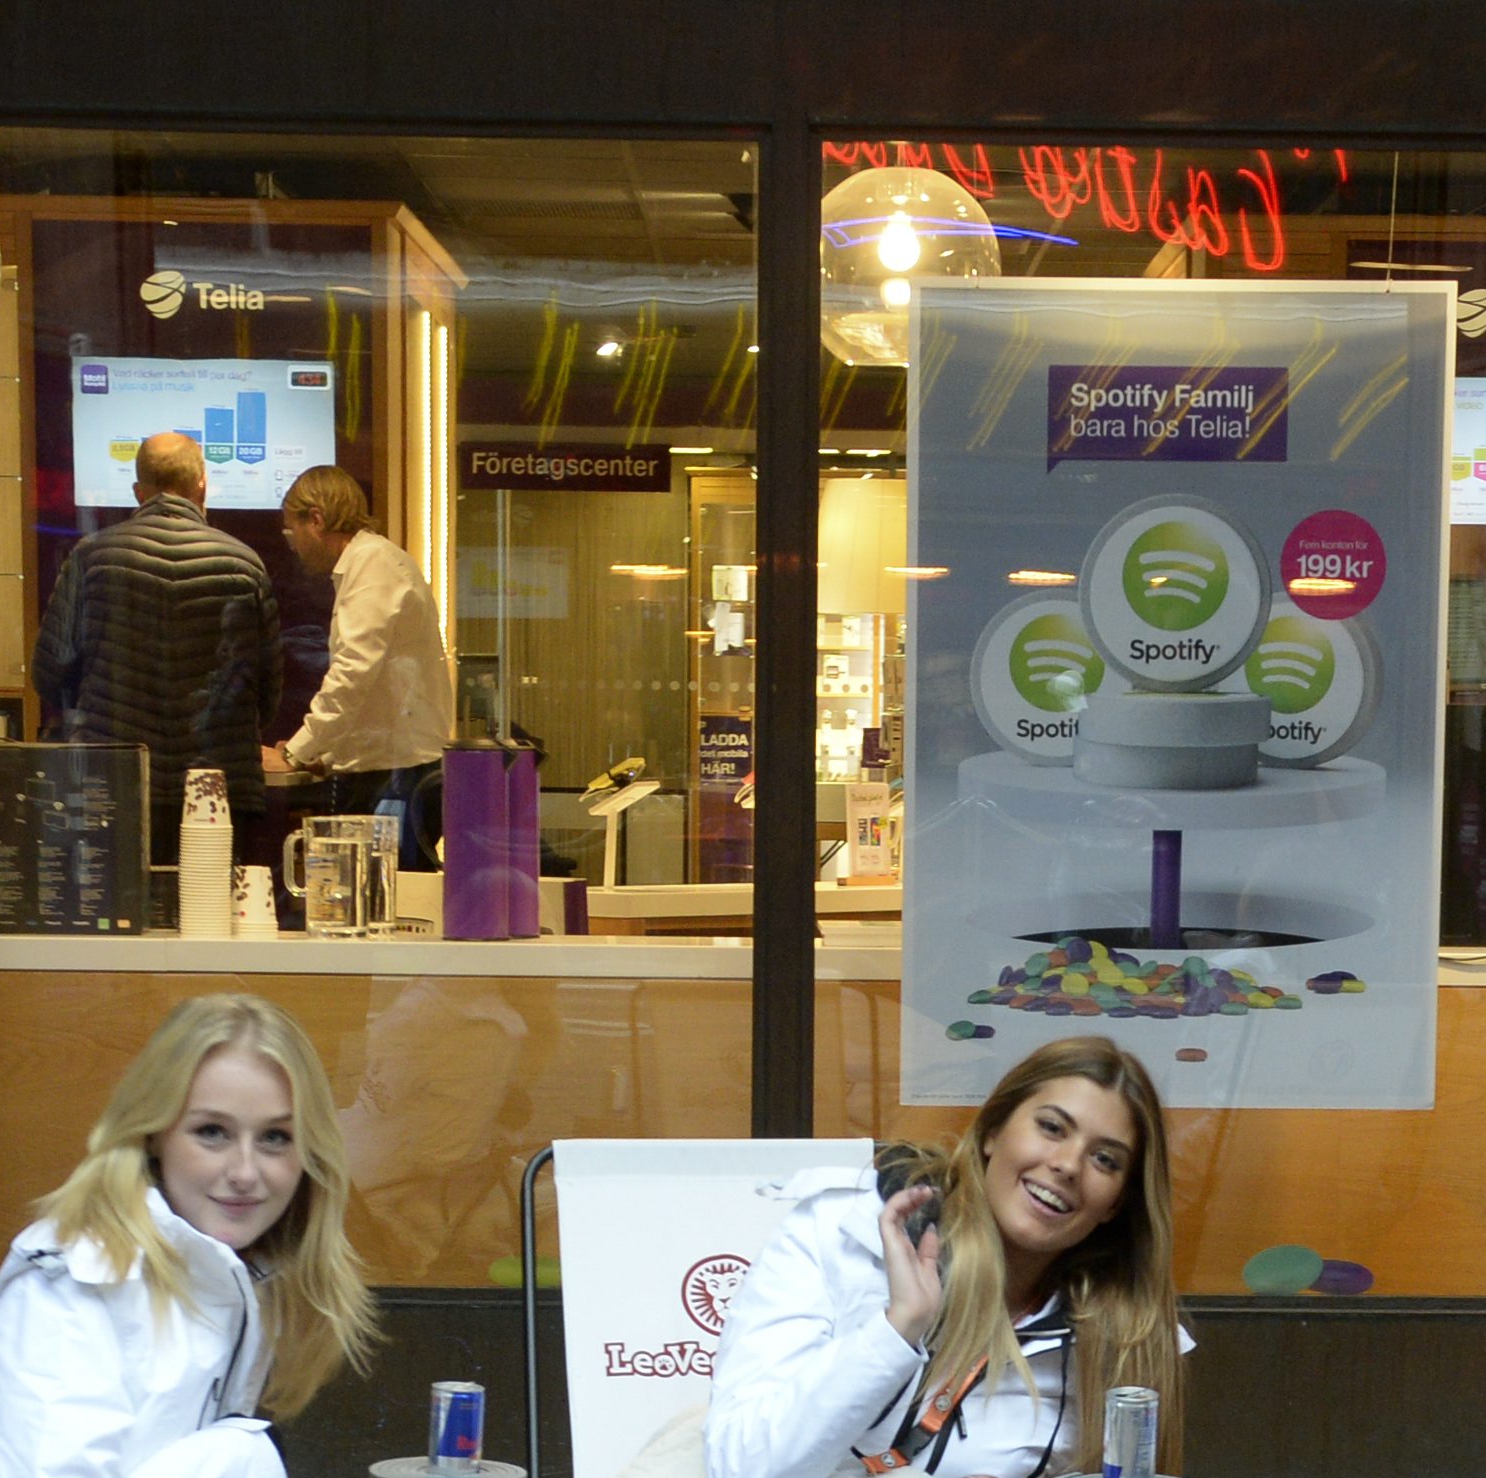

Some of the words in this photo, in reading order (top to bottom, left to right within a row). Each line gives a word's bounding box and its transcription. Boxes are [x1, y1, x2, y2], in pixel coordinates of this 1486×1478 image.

[192, 282, 265, 311] Telia
[1070, 382, 1168, 413] Spotify
[1174, 383, 1254, 413] Familj
[1070, 414, 1126, 438] bara
[1133, 414, 1180, 438] hos
[1185, 415, 1251, 438] Telia!
[471, 452, 659, 480] Företagscenter
[1296, 554, 1342, 579] 199
[1345, 554, 1374, 579] kr
[1129, 638, 1216, 665] Spotify
[700, 732, 750, 748] LADDA
[1267, 720, 1324, 744] potify
[700, 761, 736, 776] HÄR!
